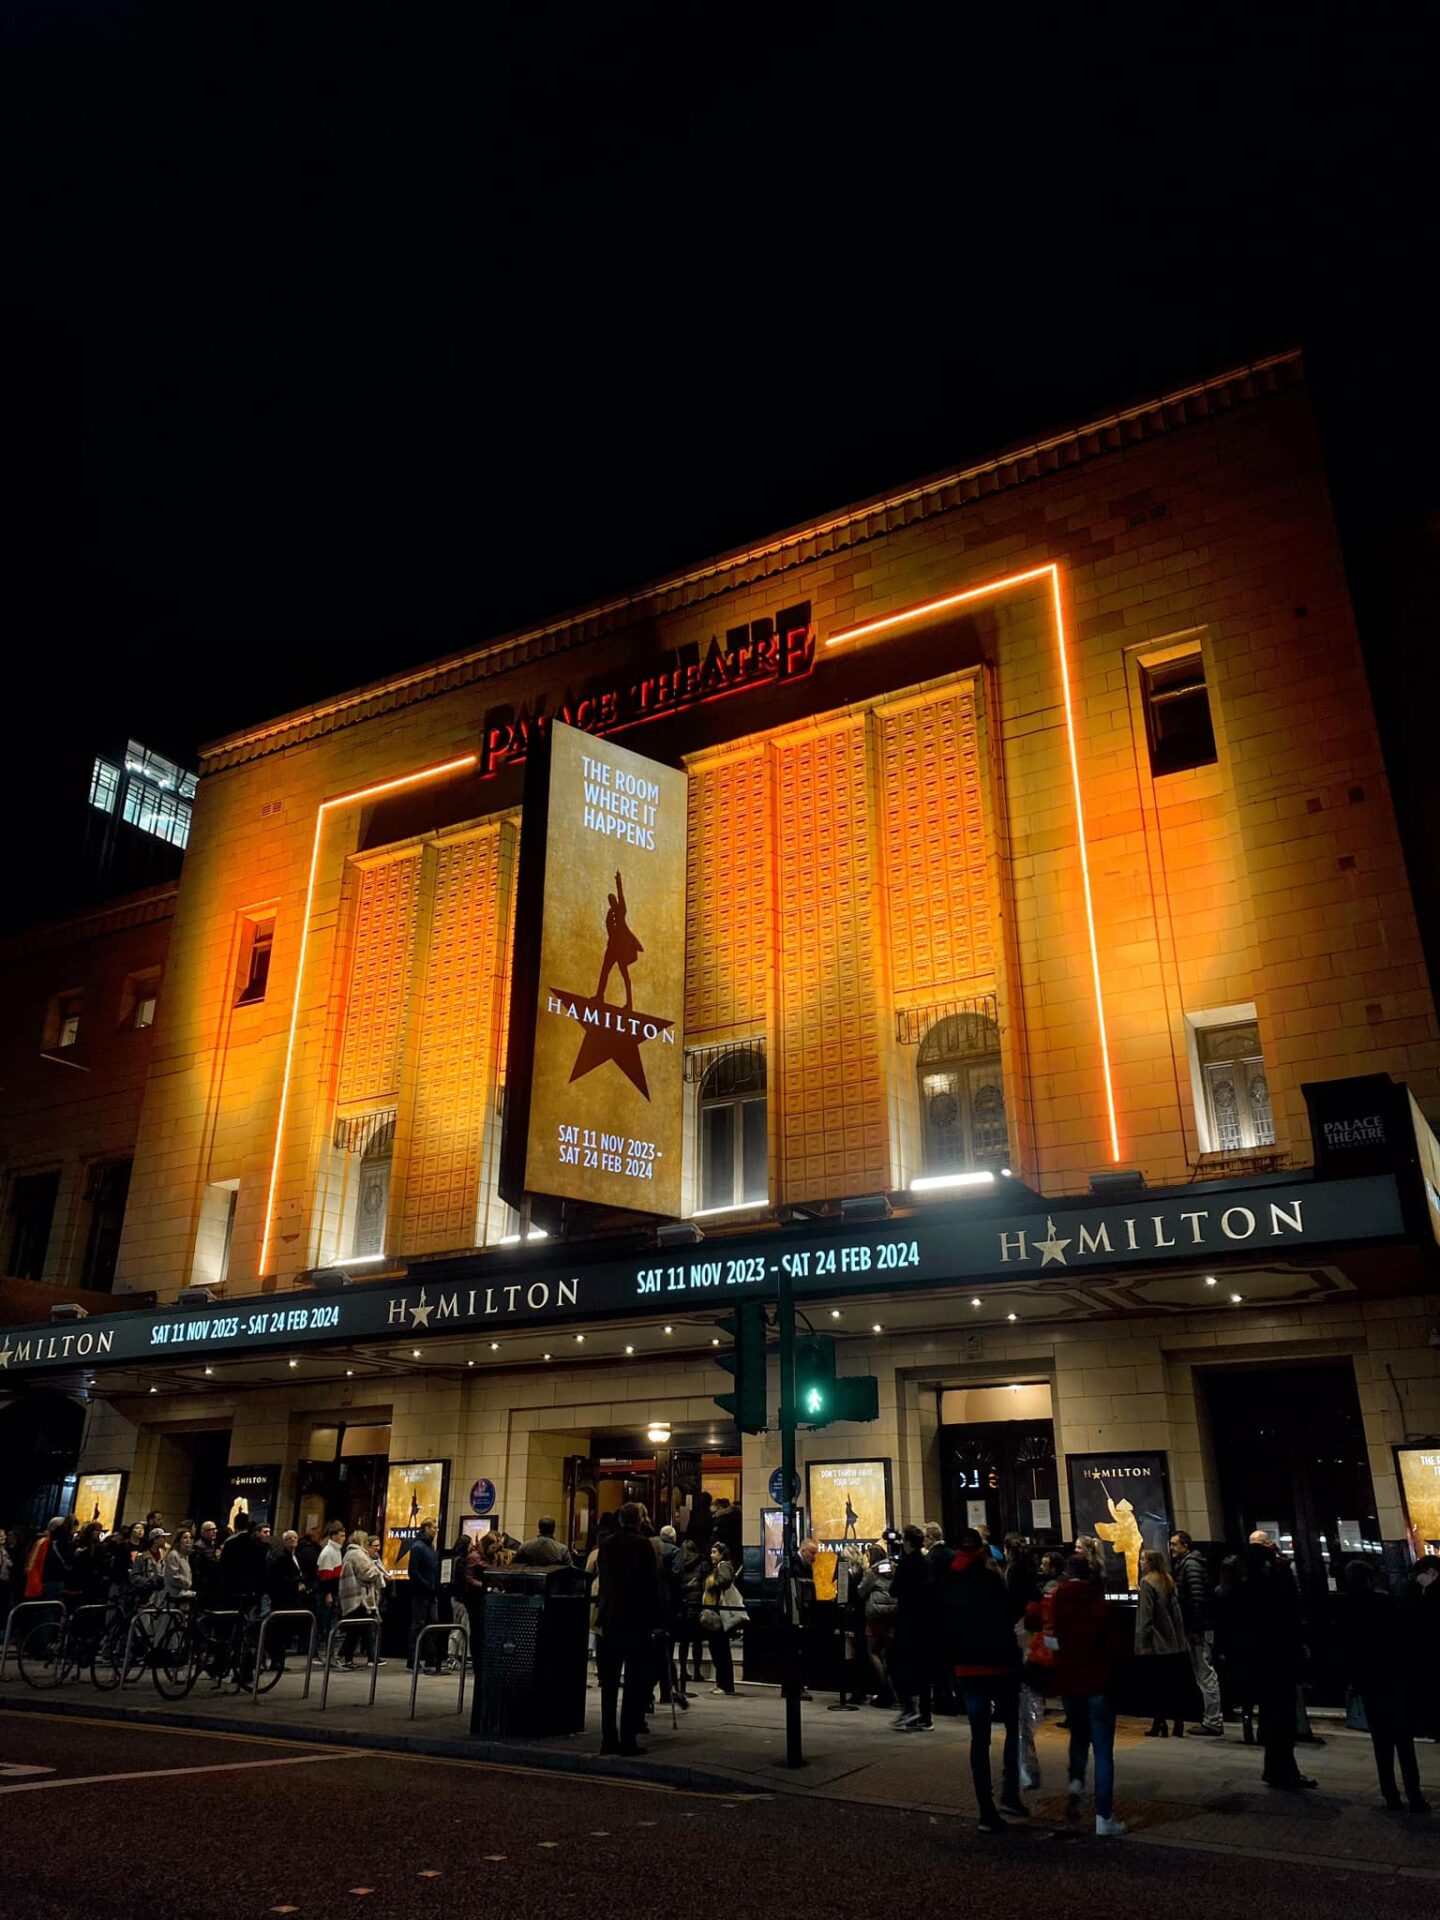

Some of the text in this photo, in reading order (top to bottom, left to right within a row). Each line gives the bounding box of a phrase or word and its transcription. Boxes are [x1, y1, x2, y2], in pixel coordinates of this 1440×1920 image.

[628, 618, 817, 712] THEATRE
[582, 756, 659, 804] THE ROOM
[584, 781, 657, 827] WHERE IT
[584, 805, 656, 851] HAPPENS
[547, 996, 675, 1045] HAMILTON
[558, 1124, 579, 1142] SAT
[583, 1130, 597, 1148] 11
[601, 1135, 625, 1154] NOV
[1323, 1115, 1384, 1134] PALACE
[1325, 1127, 1385, 1145] THEATRE
[559, 1145, 653, 1180] SAT 24 FEB 2024
[998, 1200, 1304, 1268] HAMILTON
[636, 1269, 662, 1294] SAT
[667, 1266, 686, 1290] 11
[690, 1262, 722, 1288] NOV
[726, 1257, 766, 1284] 2023
[782, 1252, 811, 1277] SAT
[815, 1250, 836, 1275] 24
[841, 1246, 871, 1272] FEB
[877, 1241, 920, 1269] 2024
[150, 1324, 171, 1345] SAT
[171, 1322, 185, 1343] 11
[187, 1319, 211, 1340] NOV
[211, 1317, 239, 1338] 2023
[247, 1313, 268, 1335] SAT
[269, 1312, 286, 1333] 24
[287, 1309, 308, 1330] FEB
[310, 1306, 340, 1328] 2024
[387, 1278, 579, 1328] HAMILTON
[1083, 1467, 1151, 1480] HAMILTON
[388, 1529, 419, 1538] HAMIL
